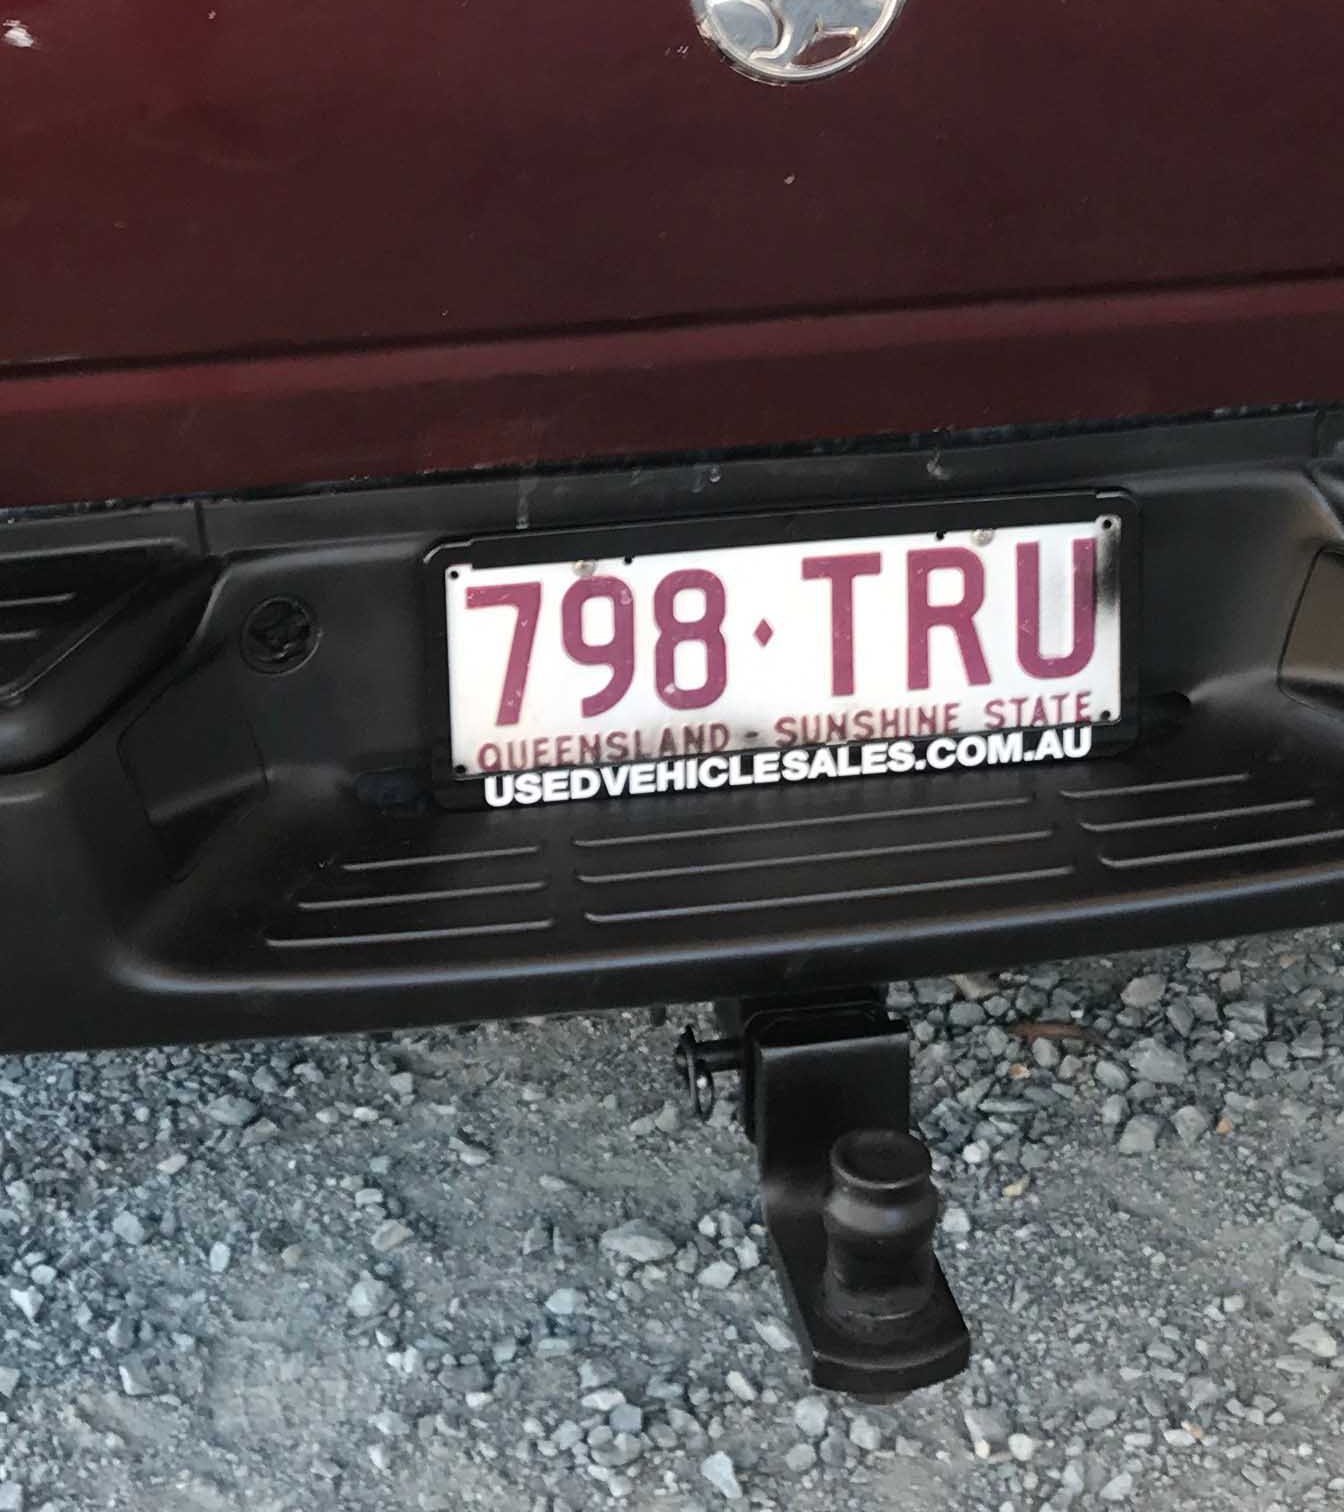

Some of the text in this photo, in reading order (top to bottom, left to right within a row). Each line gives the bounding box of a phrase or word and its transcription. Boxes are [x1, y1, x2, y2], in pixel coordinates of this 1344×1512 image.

[477, 723, 730, 774] QUEENSLAND
[774, 705, 958, 746] SUNSHINE
[984, 690, 1093, 727] STATE
[483, 726, 1093, 809] USEDVEHICLESALES.COM.AU
